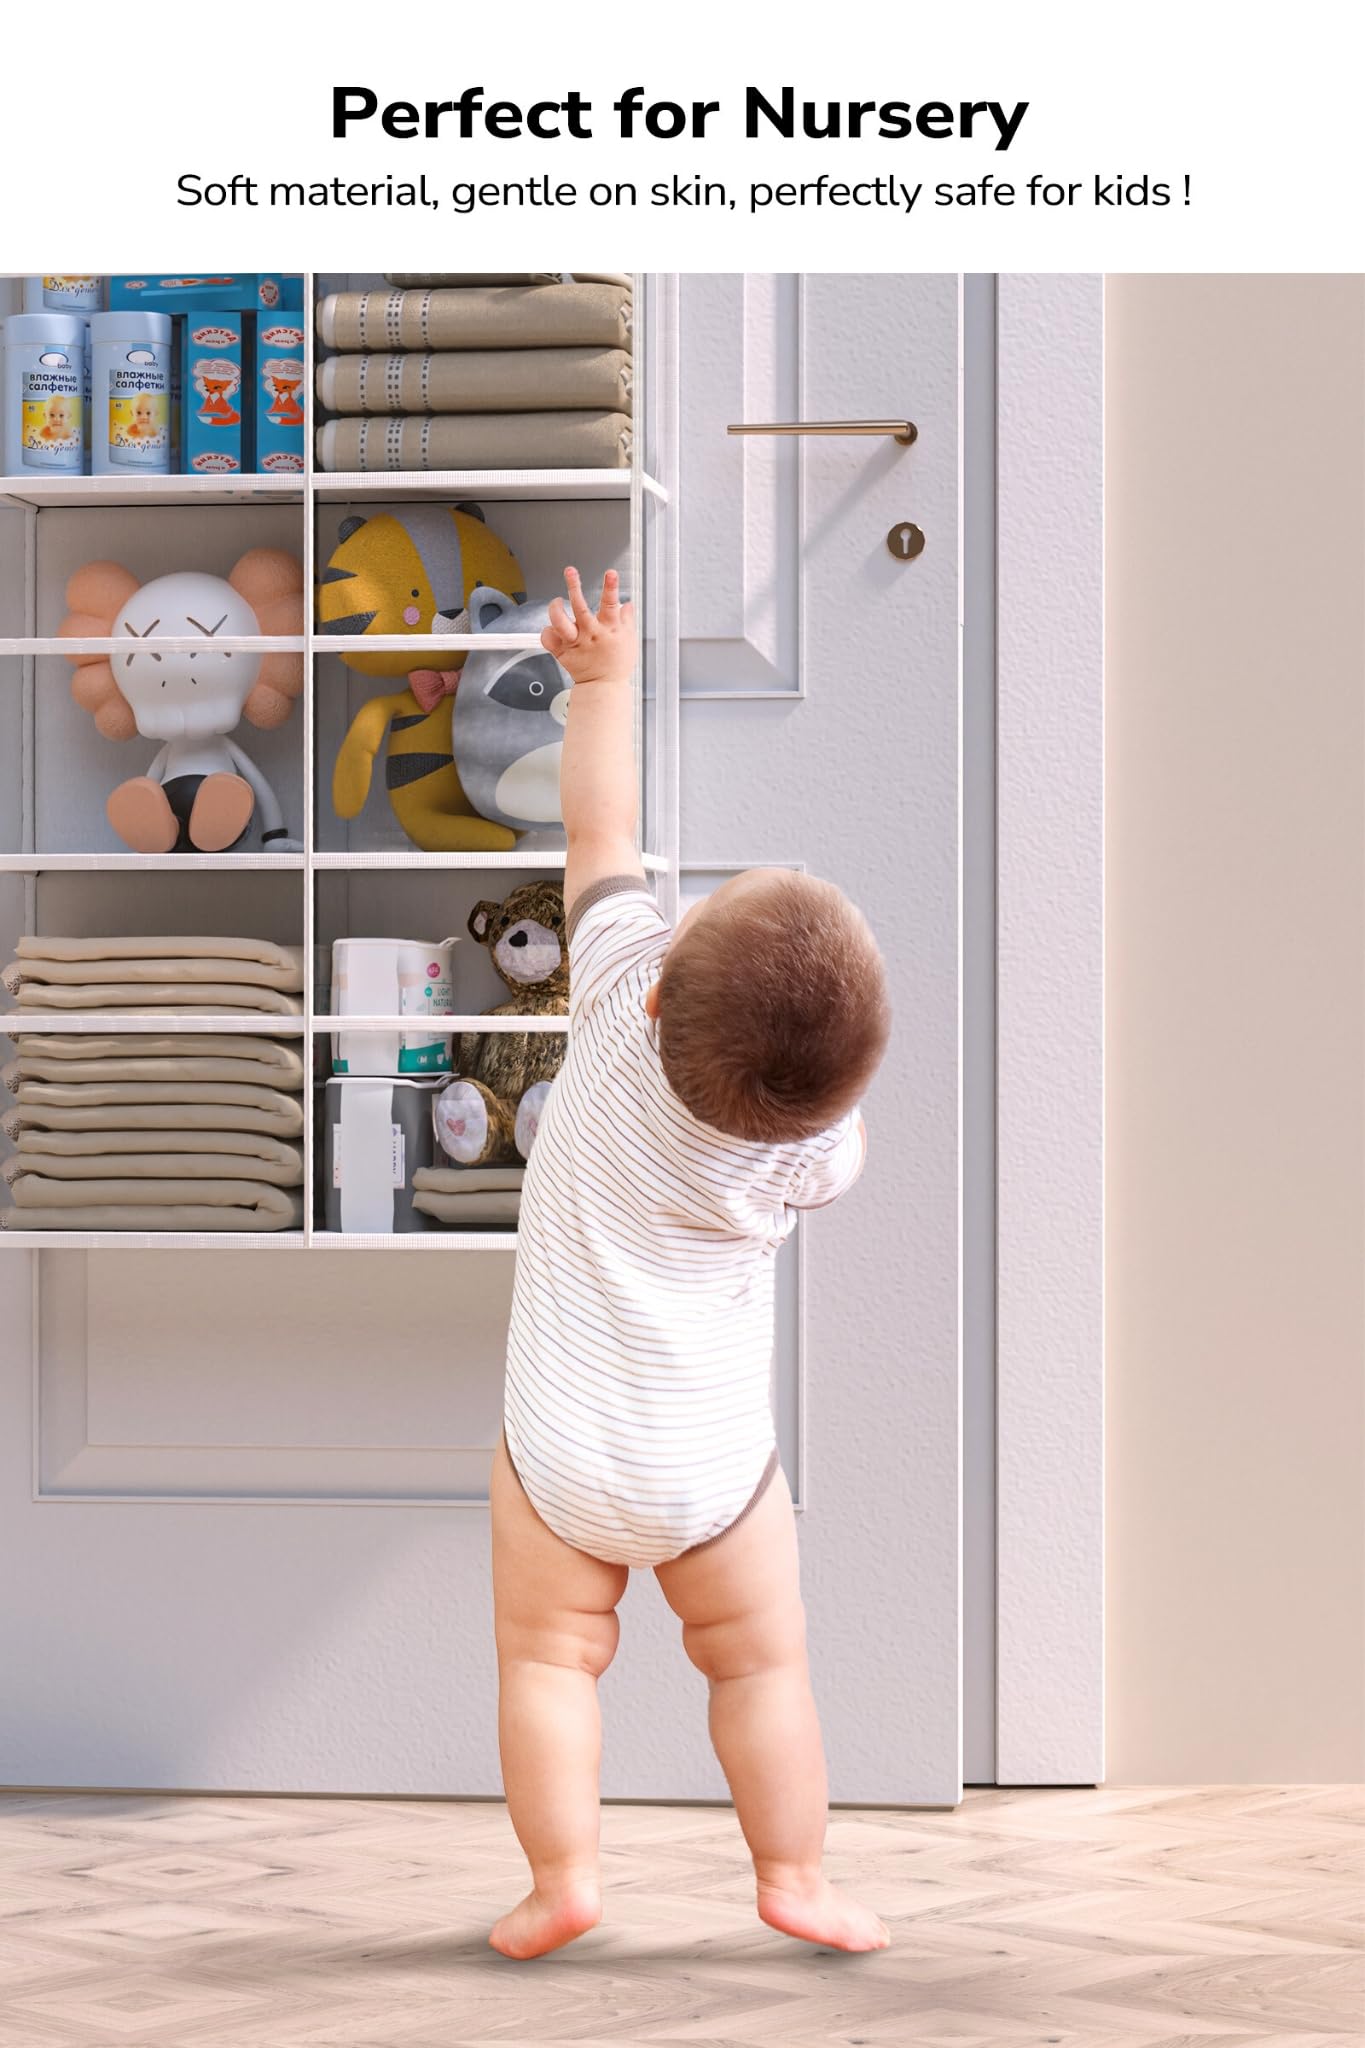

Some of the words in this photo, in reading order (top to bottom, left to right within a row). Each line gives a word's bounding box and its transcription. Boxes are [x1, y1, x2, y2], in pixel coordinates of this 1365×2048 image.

[29, 373, 77, 383] влажные
[116, 371, 164, 381] влажные
[28, 381, 78, 394] салфетки
[115, 379, 165, 391] салфетки
